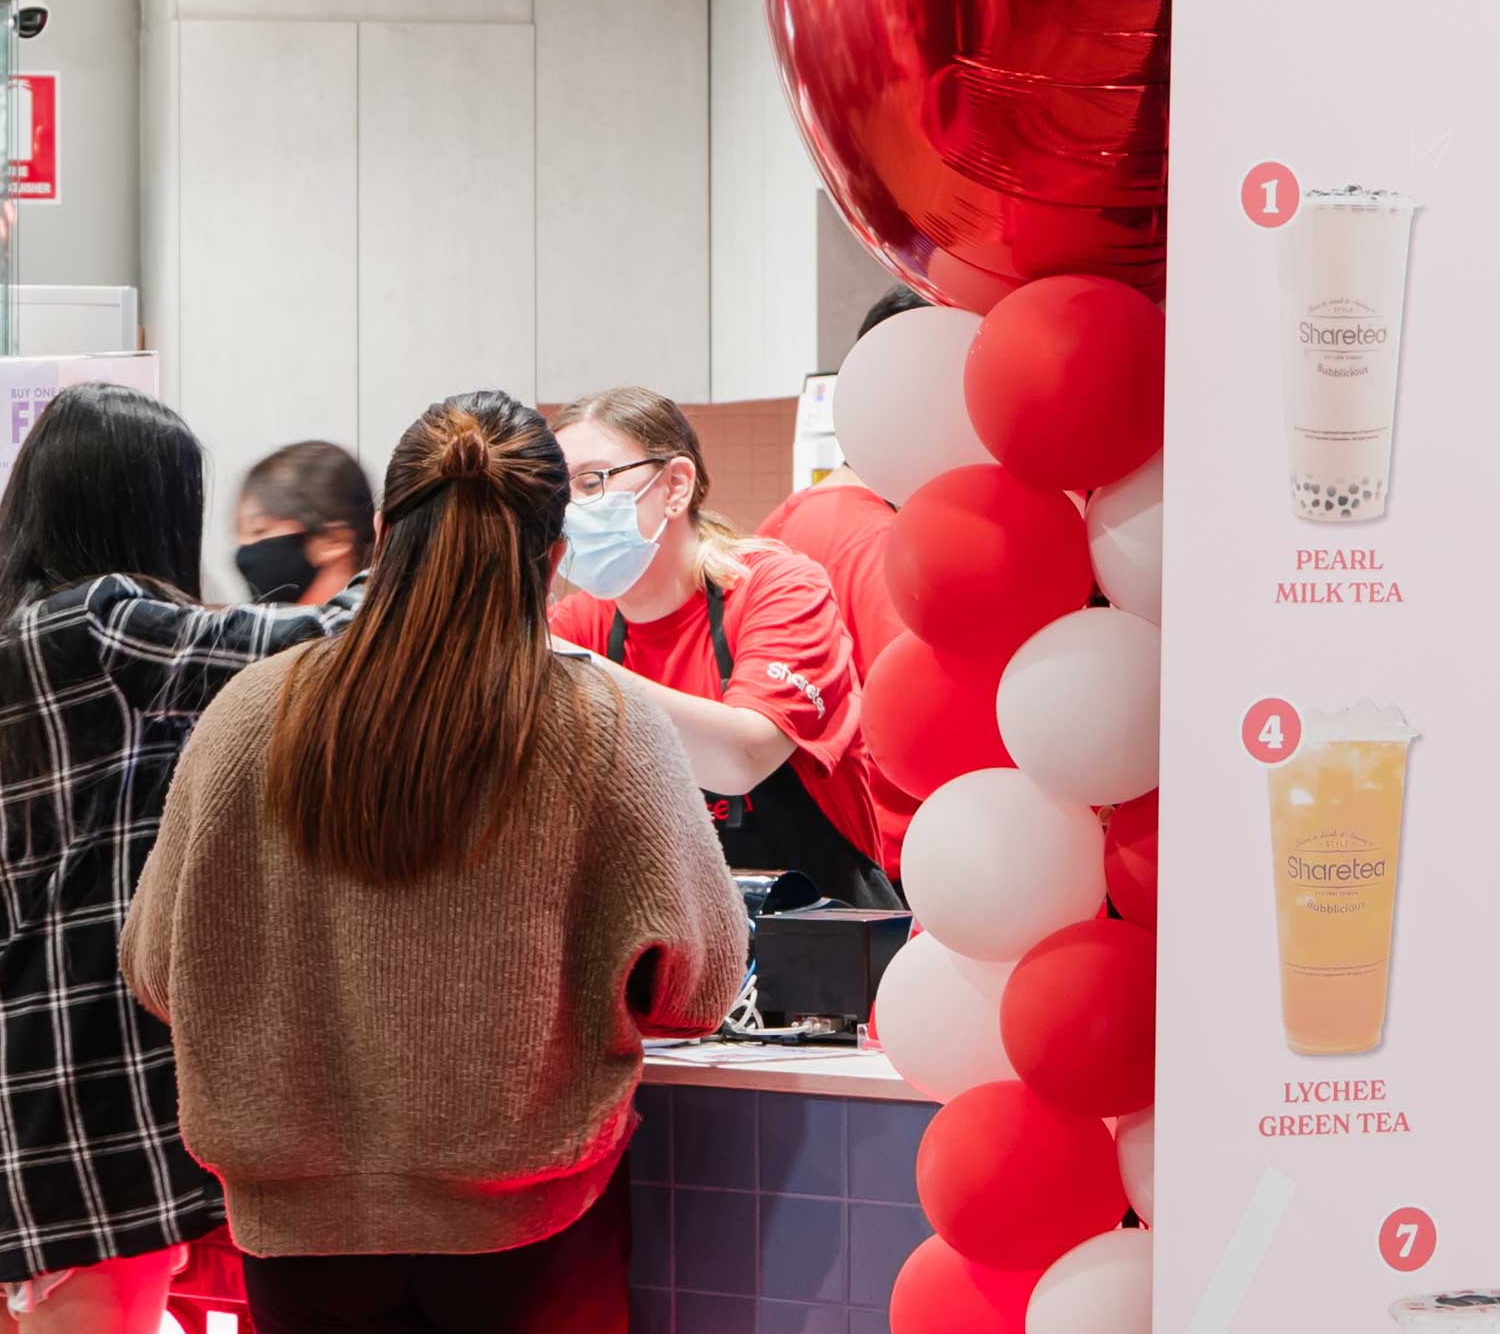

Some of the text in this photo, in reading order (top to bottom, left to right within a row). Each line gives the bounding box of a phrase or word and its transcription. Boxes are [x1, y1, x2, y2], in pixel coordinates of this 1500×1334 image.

[1258, 178, 1280, 214] 1
[1299, 321, 1387, 346] Sharetea
[10, 387, 56, 399] BUY ONE
[1296, 548, 1383, 571] PEARL
[1275, 581, 1403, 603] MILK TEA
[1257, 714, 1285, 749] 4
[1287, 856, 1386, 881] Sharetea
[1306, 899, 1366, 914] Bubblicious
[1284, 1079, 1385, 1104] LYCHEE
[1258, 1112, 1410, 1138] GREEN TEA
[1396, 1223, 1418, 1258] 7
